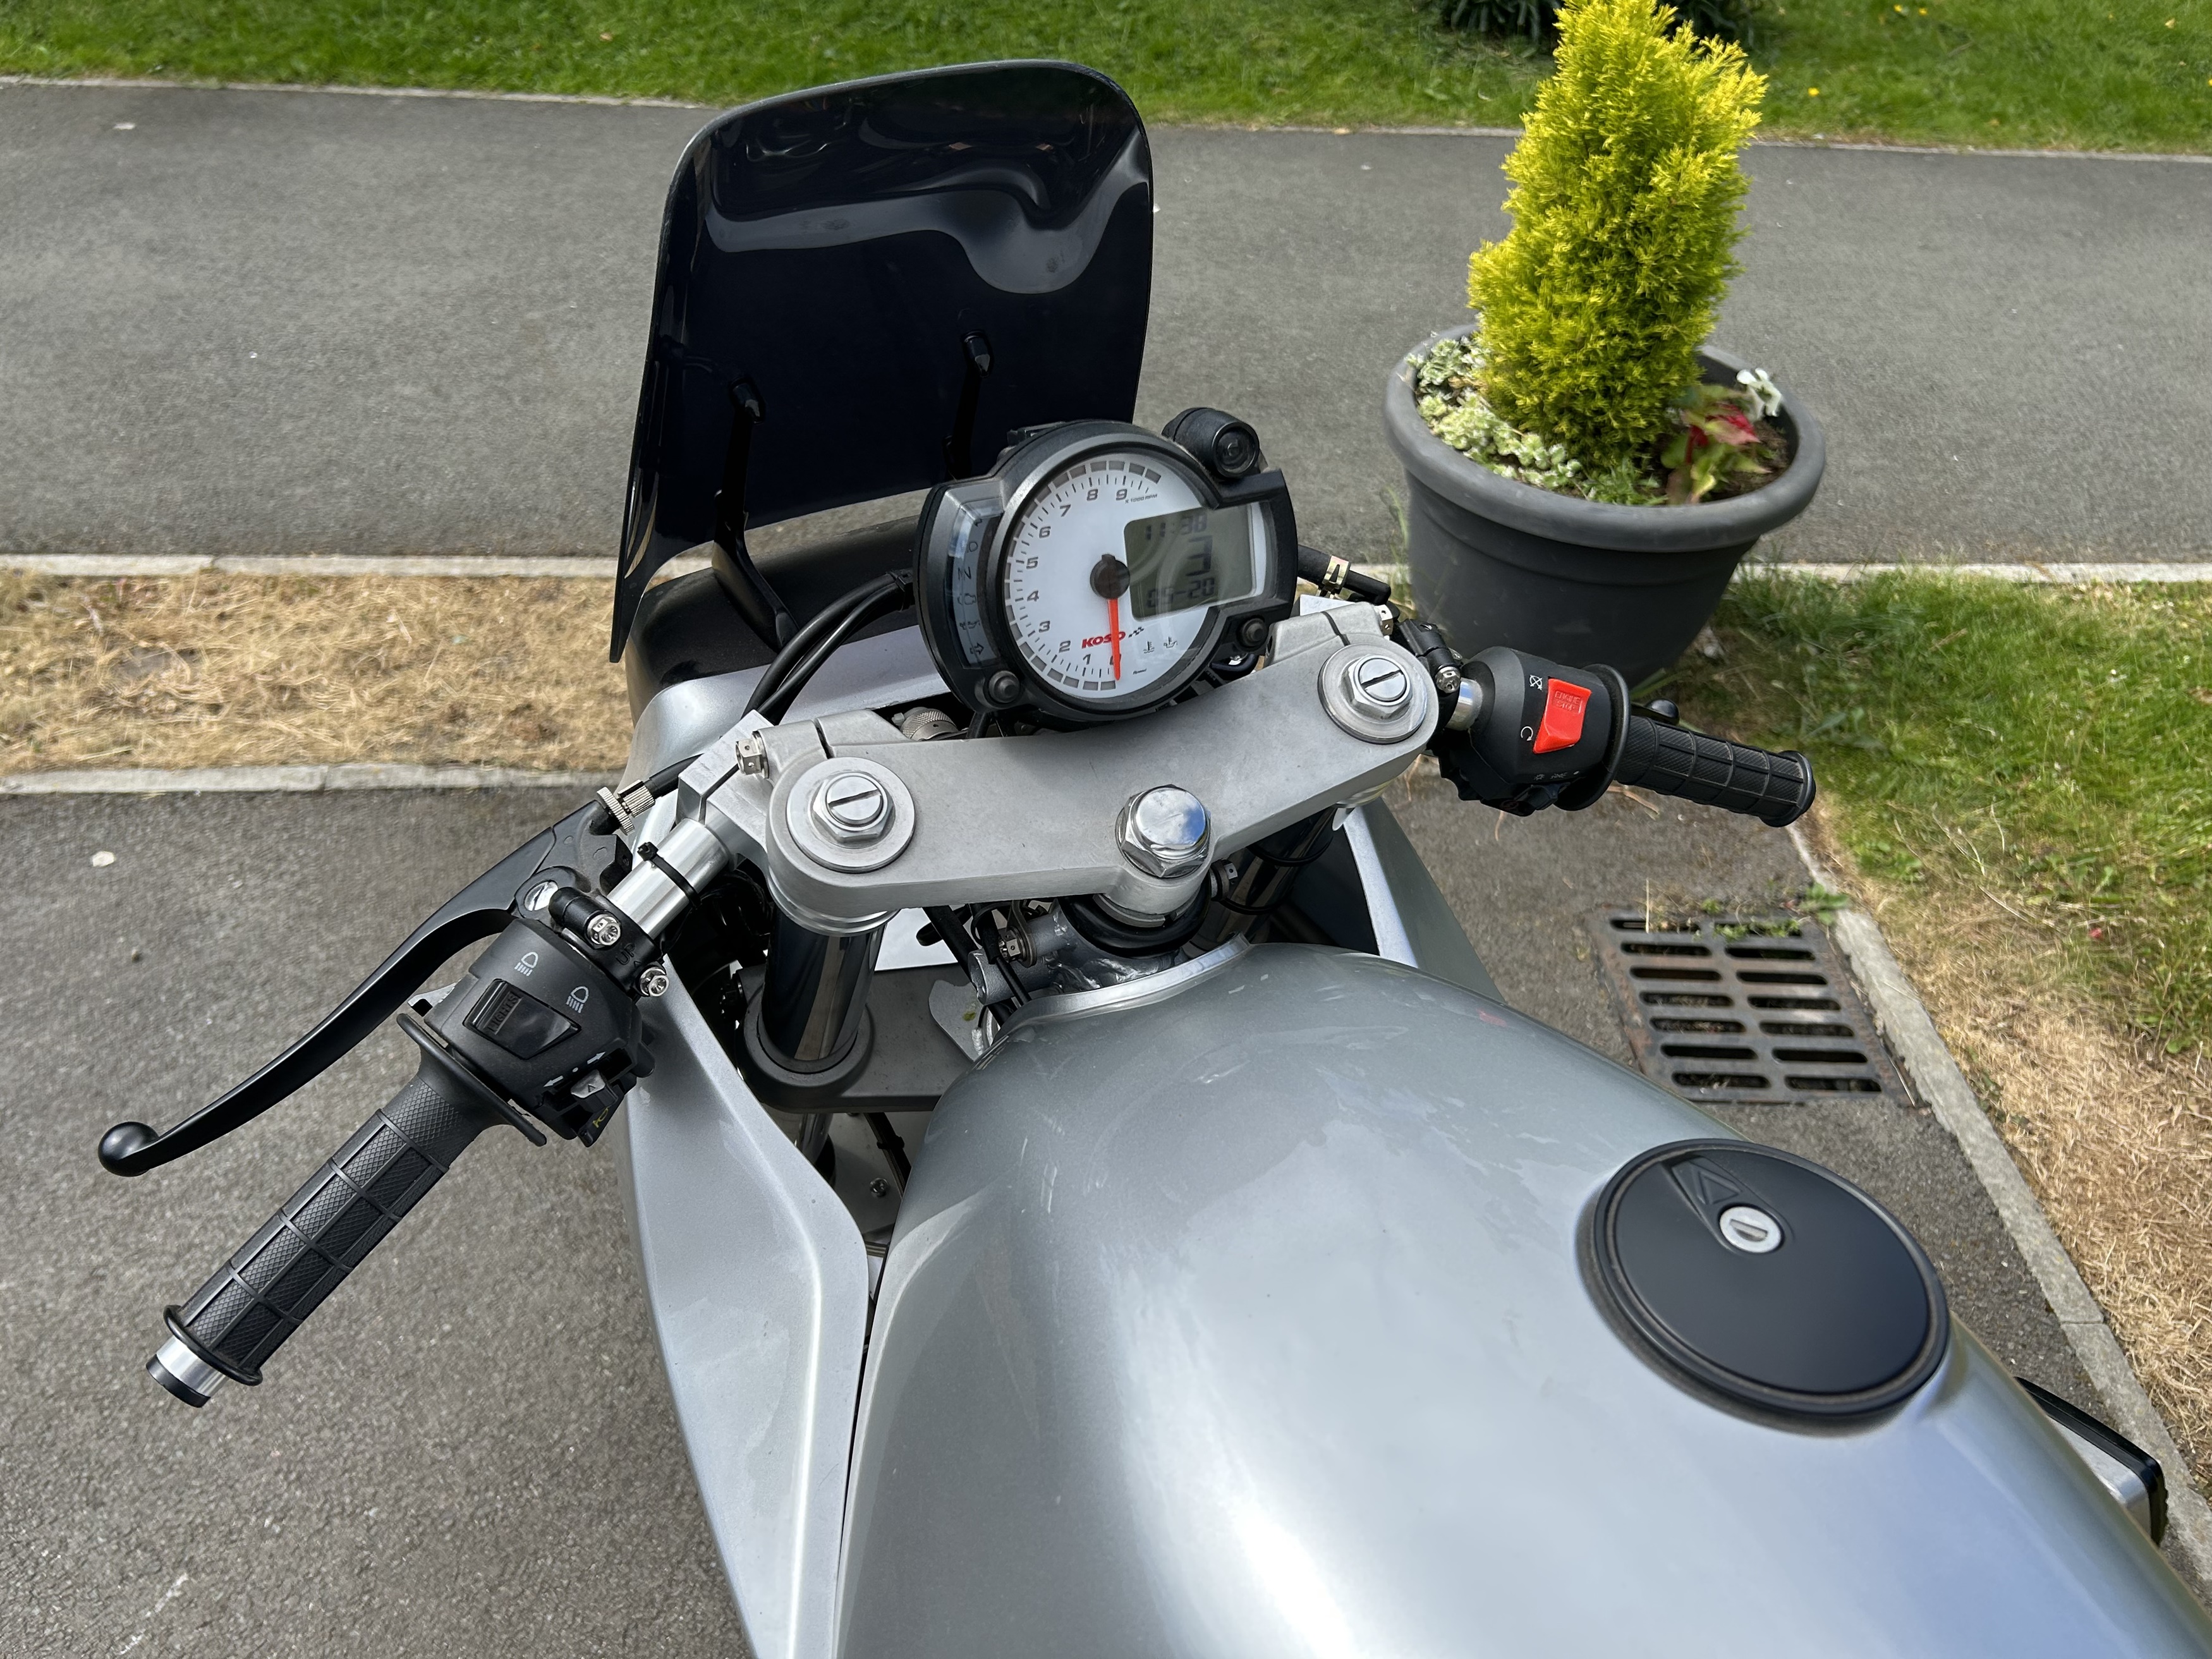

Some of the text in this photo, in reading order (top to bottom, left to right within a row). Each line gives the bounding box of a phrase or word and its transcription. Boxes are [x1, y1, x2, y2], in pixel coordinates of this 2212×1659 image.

[1086, 489, 1098, 501] 8
[1115, 489, 1127, 501] 9
[1059, 504, 1071, 517] 7
[1039, 526, 1051, 538] 6
[1026, 557, 1038, 569] 5
[1027, 590, 1039, 602] 4
[1038, 621, 1050, 633] 3
[1059, 640, 1071, 653] 2
[1082, 653, 1091, 665] 1
[615, 943, 636, 965] UP
[487, 993, 518, 1033] LIGHTS
